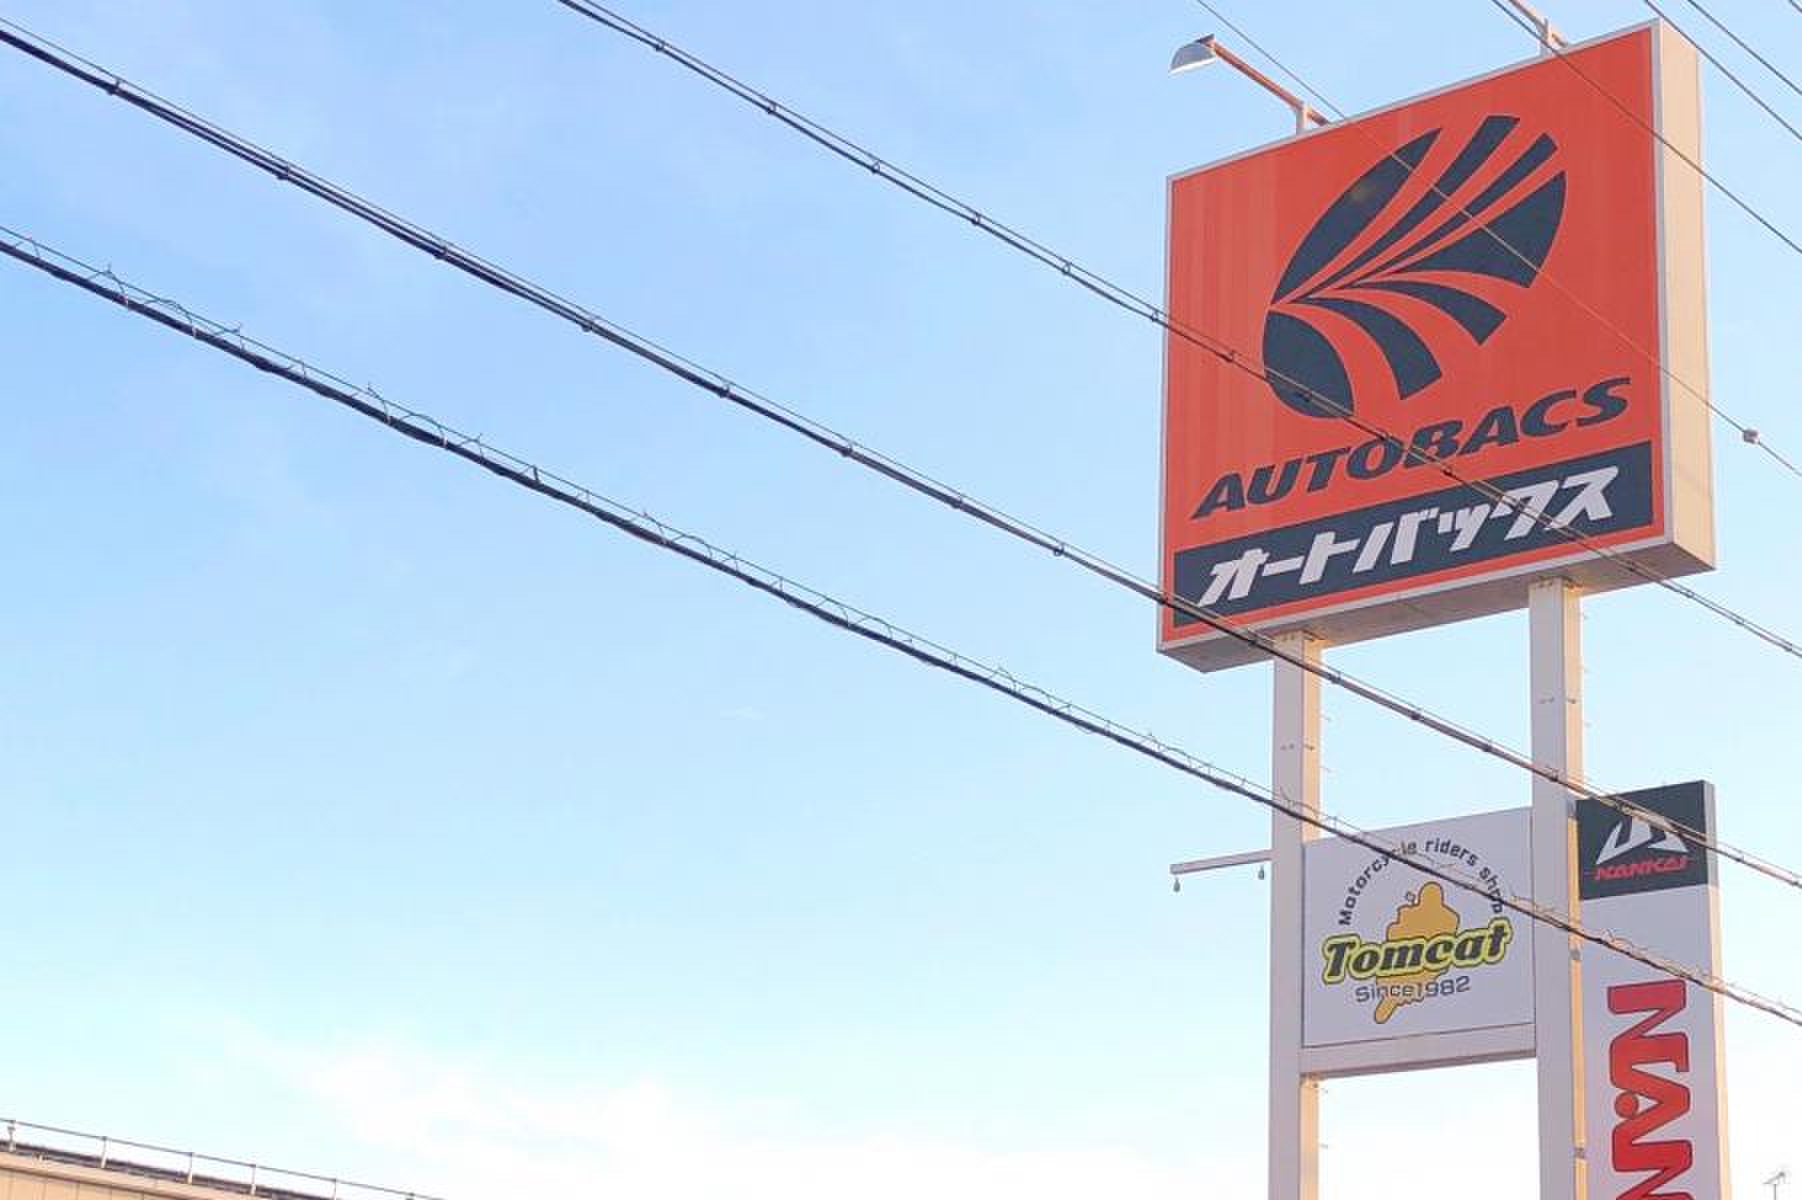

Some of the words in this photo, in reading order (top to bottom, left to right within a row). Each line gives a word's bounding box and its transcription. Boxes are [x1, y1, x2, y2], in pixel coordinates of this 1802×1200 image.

[1191, 377, 1631, 520] AUTOBACS
[1197, 465, 1619, 607] オートバックス
[1425, 837, 1479, 867] riders
[1322, 916, 1514, 985] Tomcat
